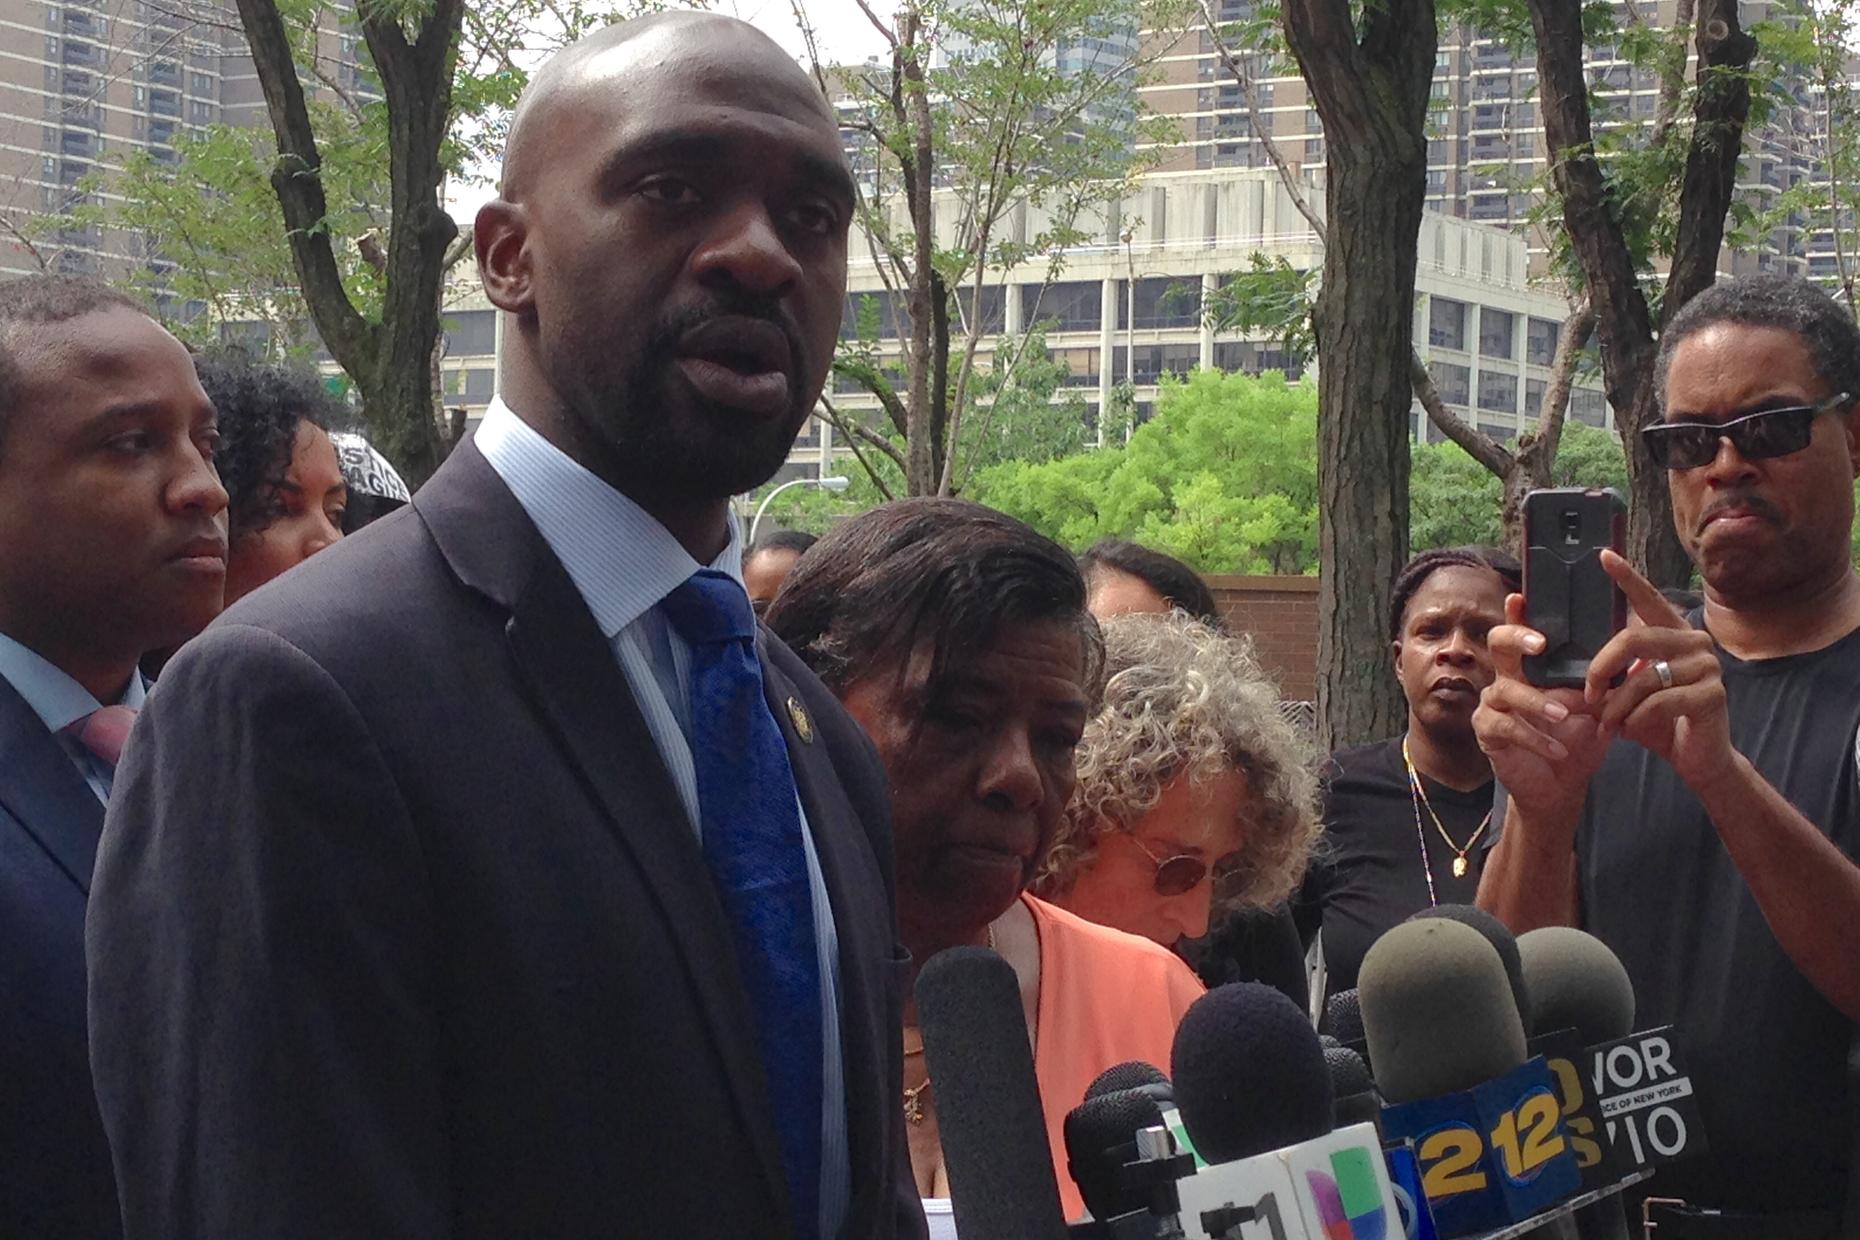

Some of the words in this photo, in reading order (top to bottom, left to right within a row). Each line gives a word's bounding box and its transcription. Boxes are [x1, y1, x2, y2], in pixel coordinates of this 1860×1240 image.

[1618, 1098, 1632, 1109] OF
[1633, 1092, 1655, 1104] NEW
[1656, 1085, 1682, 1098] YORK
[1490, 1093, 1565, 1177] 12
